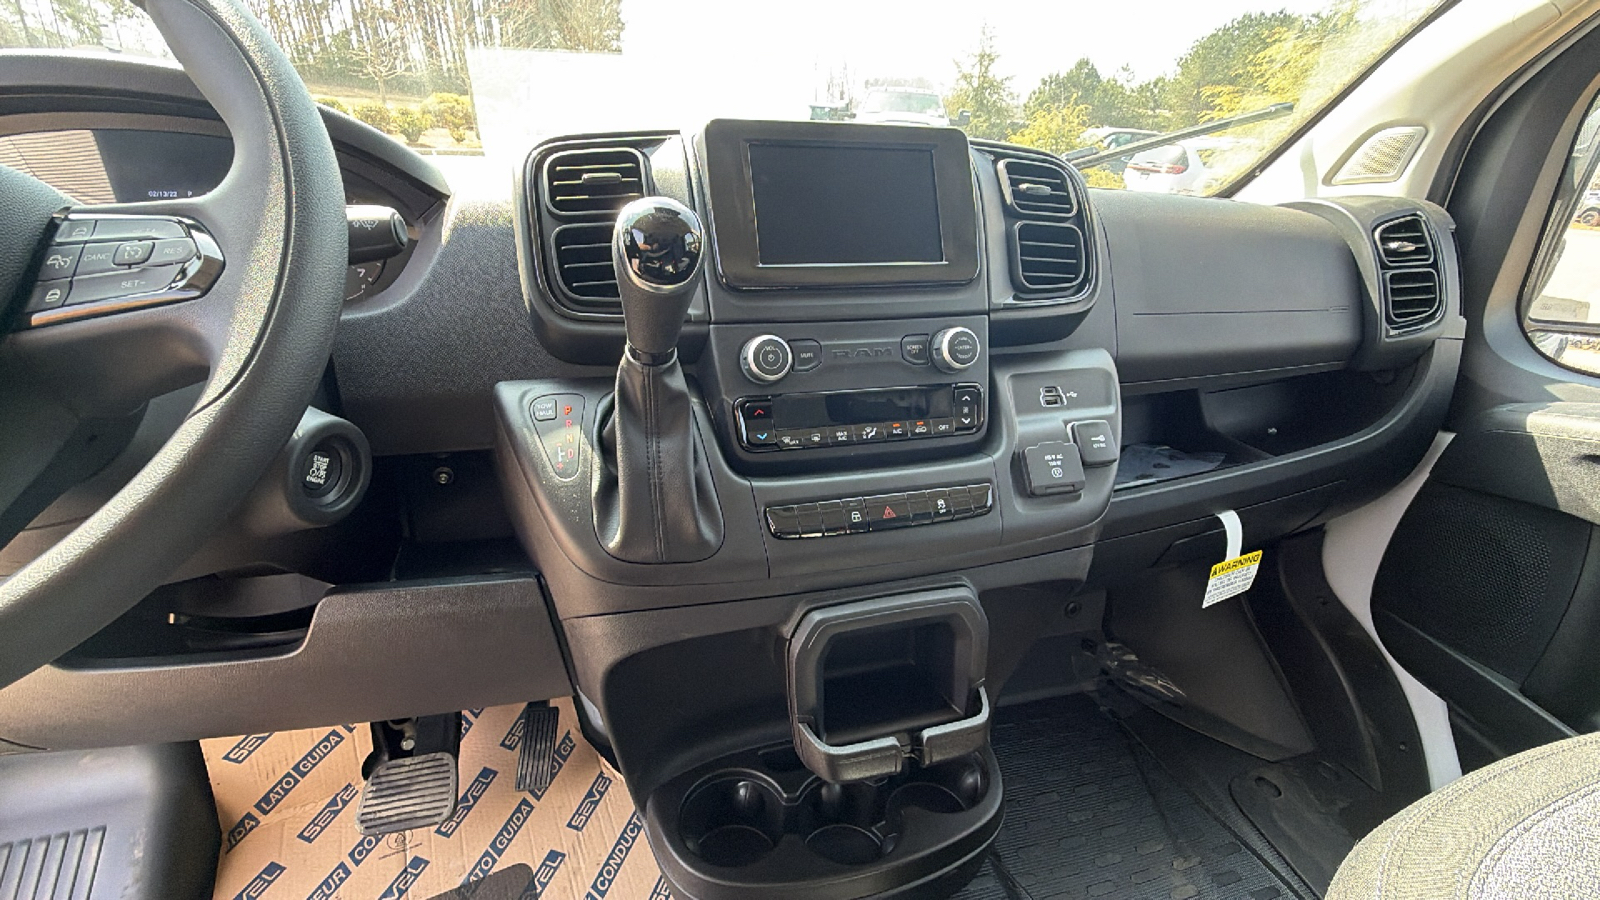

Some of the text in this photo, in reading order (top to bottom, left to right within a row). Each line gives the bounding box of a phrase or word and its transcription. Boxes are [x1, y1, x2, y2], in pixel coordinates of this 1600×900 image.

[84, 253, 111, 261] CANC
[831, 346, 894, 359] RAM
[564, 405, 572, 416] P
[565, 419, 573, 429] R
[566, 433, 574, 443] N
[567, 448, 574, 459] D
[1218, 553, 1261, 574] WARNING
[504, 719, 525, 748] SE
[260, 733, 341, 810] LATO GUIDA
[302, 783, 359, 840] SEVE
[441, 772, 495, 834] SEVEL
[571, 775, 611, 828] SEVE
[228, 819, 256, 846] IDA
[469, 804, 533, 883] ATO GUIDA
[310, 868, 347, 900] EUR
[354, 836, 378, 860] CO
[596, 814, 642, 891] CONDUCT
[382, 863, 425, 900] VEL
[534, 856, 563, 893] VEL
